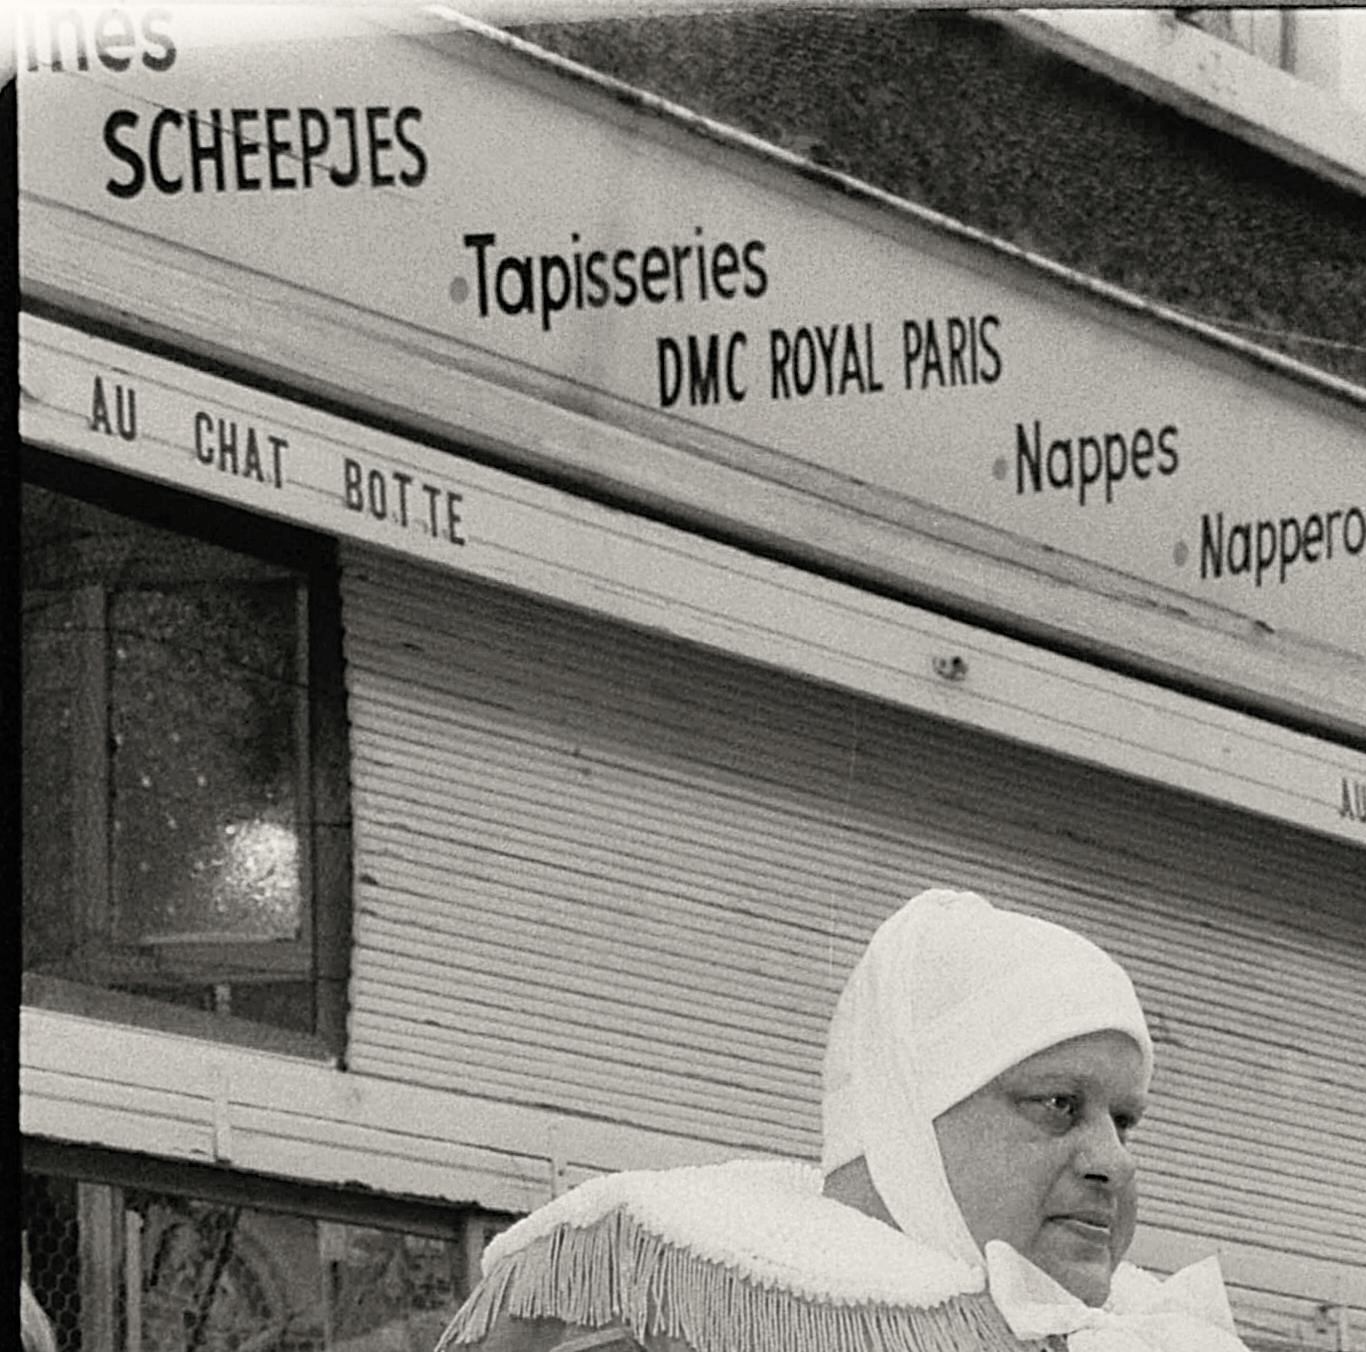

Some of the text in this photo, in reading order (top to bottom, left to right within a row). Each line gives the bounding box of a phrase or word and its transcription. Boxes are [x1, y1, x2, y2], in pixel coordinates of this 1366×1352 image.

[103, 105, 427, 199] SCHEEPJES
[464, 226, 768, 331] Tapisseries
[657, 315, 1001, 408] DMC ROYAL PARIS
[90, 375, 466, 545] AU CHAT BOTTE
[1015, 420, 1179, 507] Nappes
